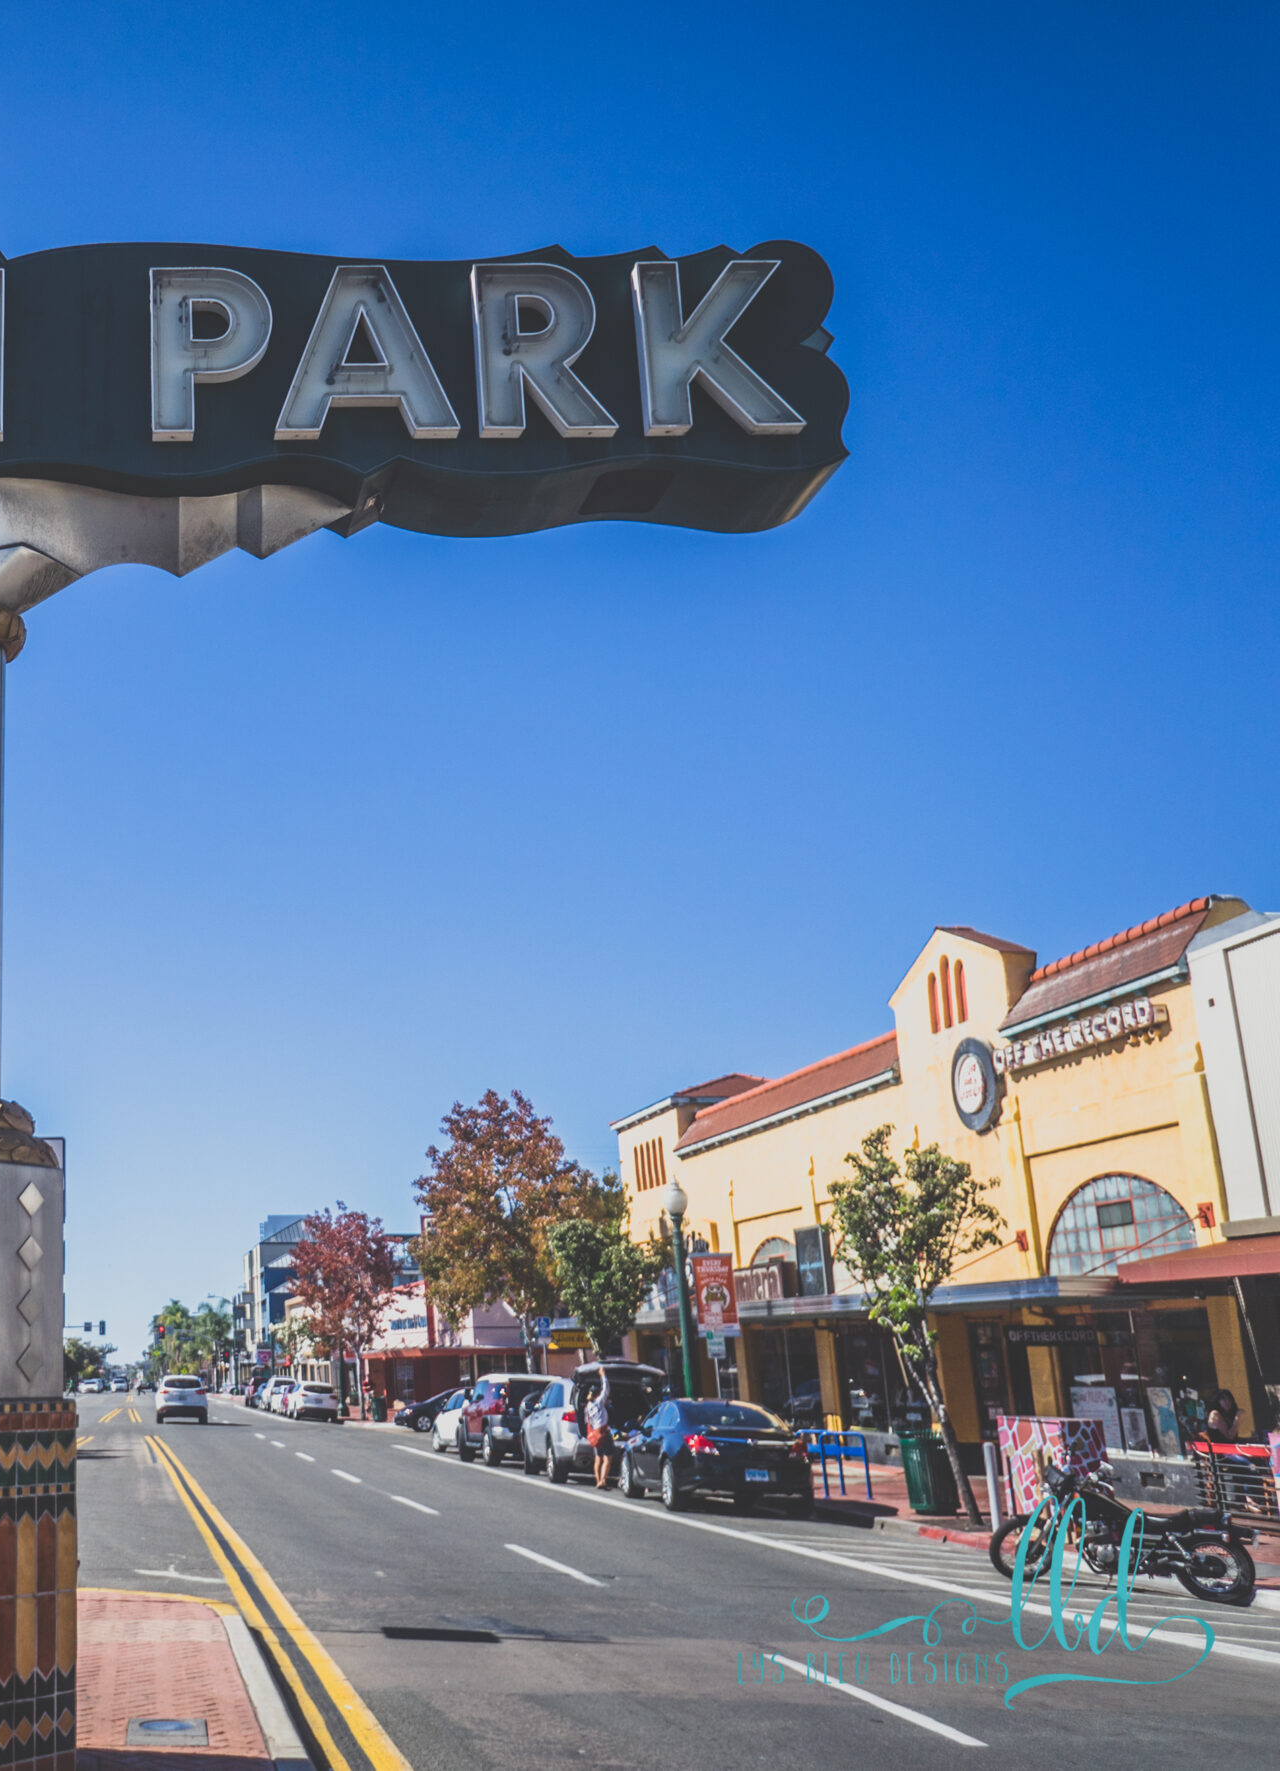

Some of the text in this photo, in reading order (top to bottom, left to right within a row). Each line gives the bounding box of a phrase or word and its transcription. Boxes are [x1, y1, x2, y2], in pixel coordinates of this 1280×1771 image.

[150, 259, 807, 442] PARK
[992, 997, 1154, 1074] OFF THE RECORD
